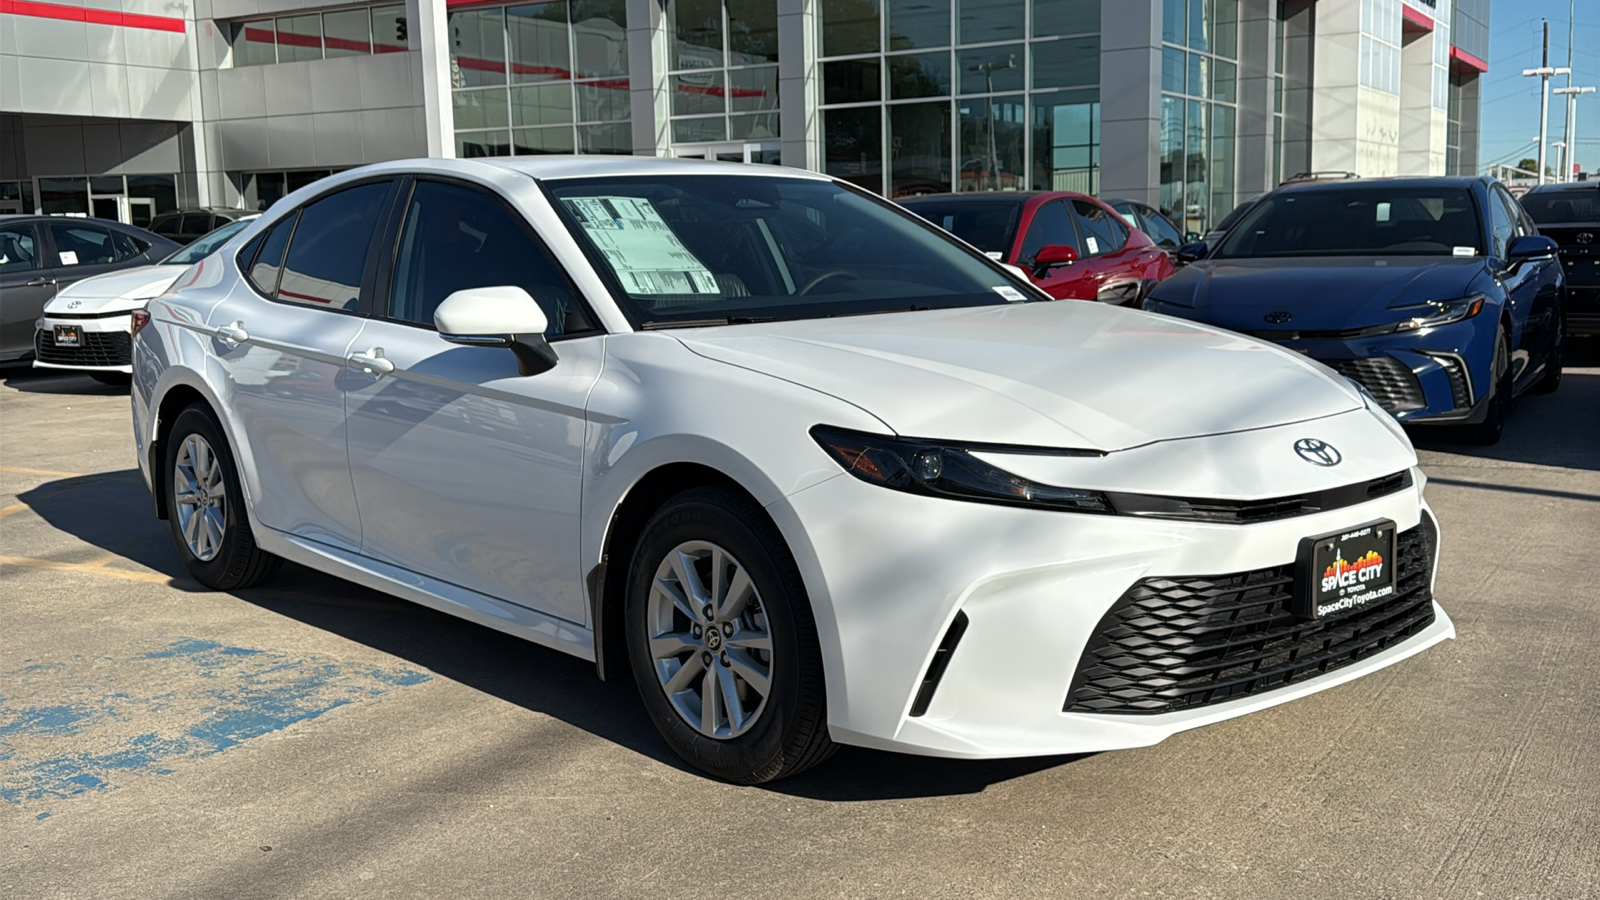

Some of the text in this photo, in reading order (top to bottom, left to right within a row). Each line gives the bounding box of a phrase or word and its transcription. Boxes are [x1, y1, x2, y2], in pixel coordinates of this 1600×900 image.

[1321, 563, 1383, 592] SPACE CITY
[1347, 584, 1366, 593] TOYOTA
[1317, 586, 1392, 616] SpaceCityToyota.com
